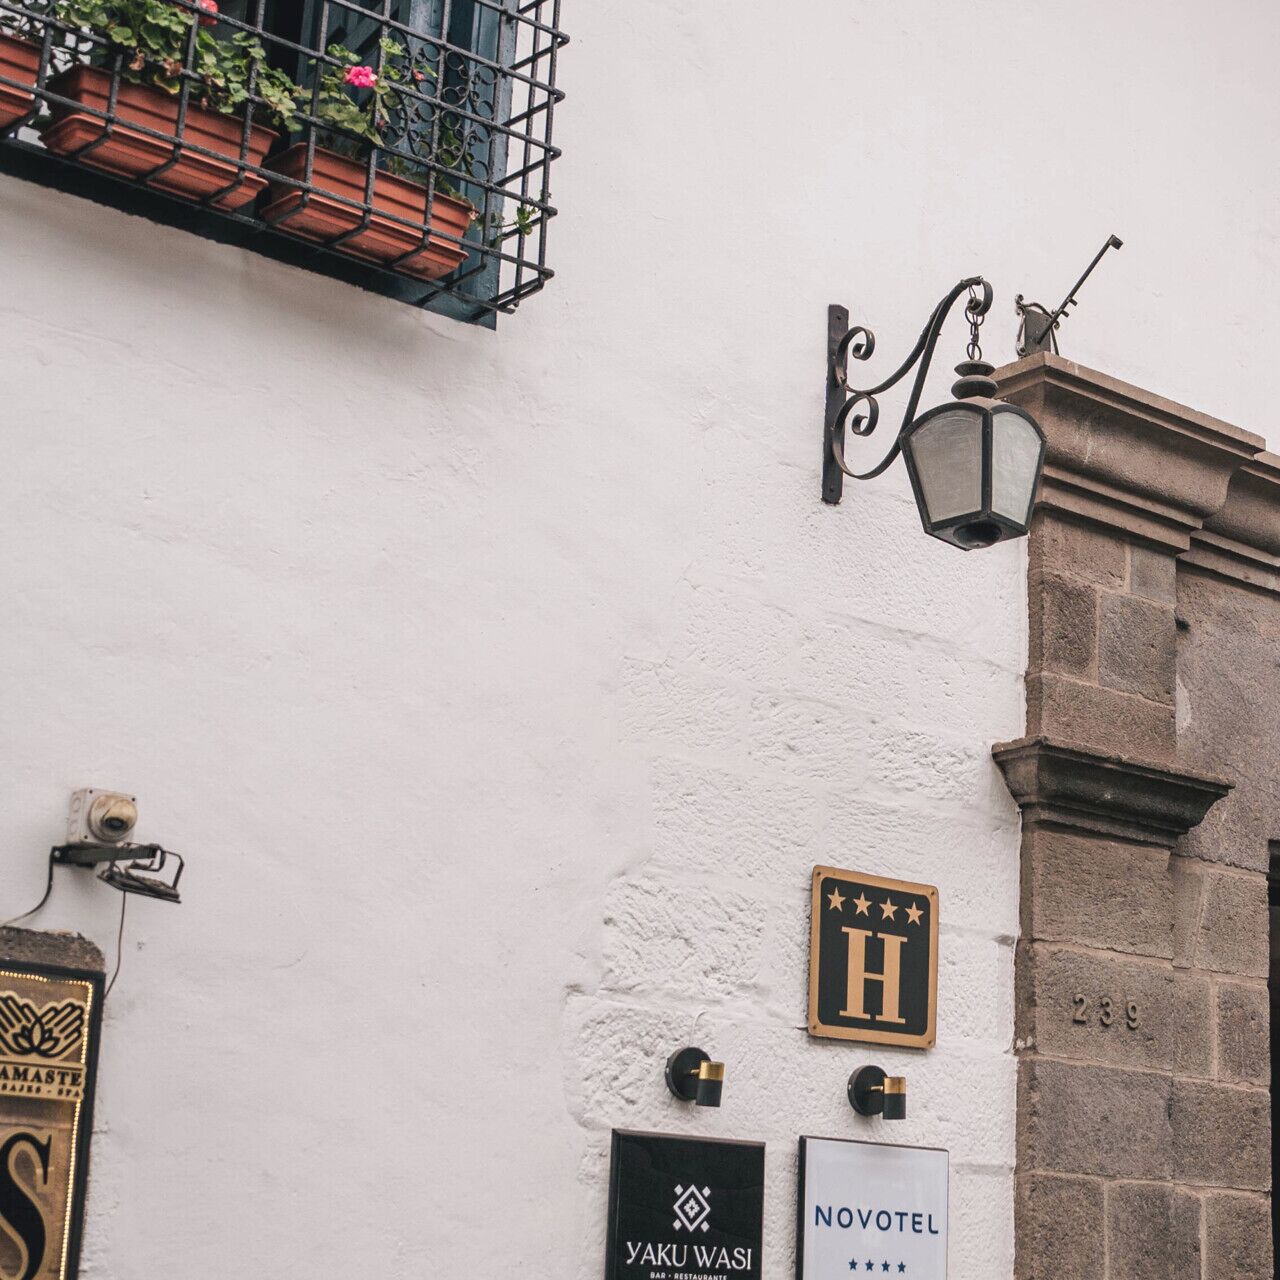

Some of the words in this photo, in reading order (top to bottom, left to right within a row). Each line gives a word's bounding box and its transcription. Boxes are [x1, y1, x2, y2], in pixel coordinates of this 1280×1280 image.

[838, 926, 908, 1025] H
[1072, 993, 1141, 1031] 239
[814, 1205, 939, 1235] NOVOTEL
[626, 1241, 688, 1267] YAKU
[693, 1245, 752, 1270] WASI
[650, 1271, 666, 1280] BAR
